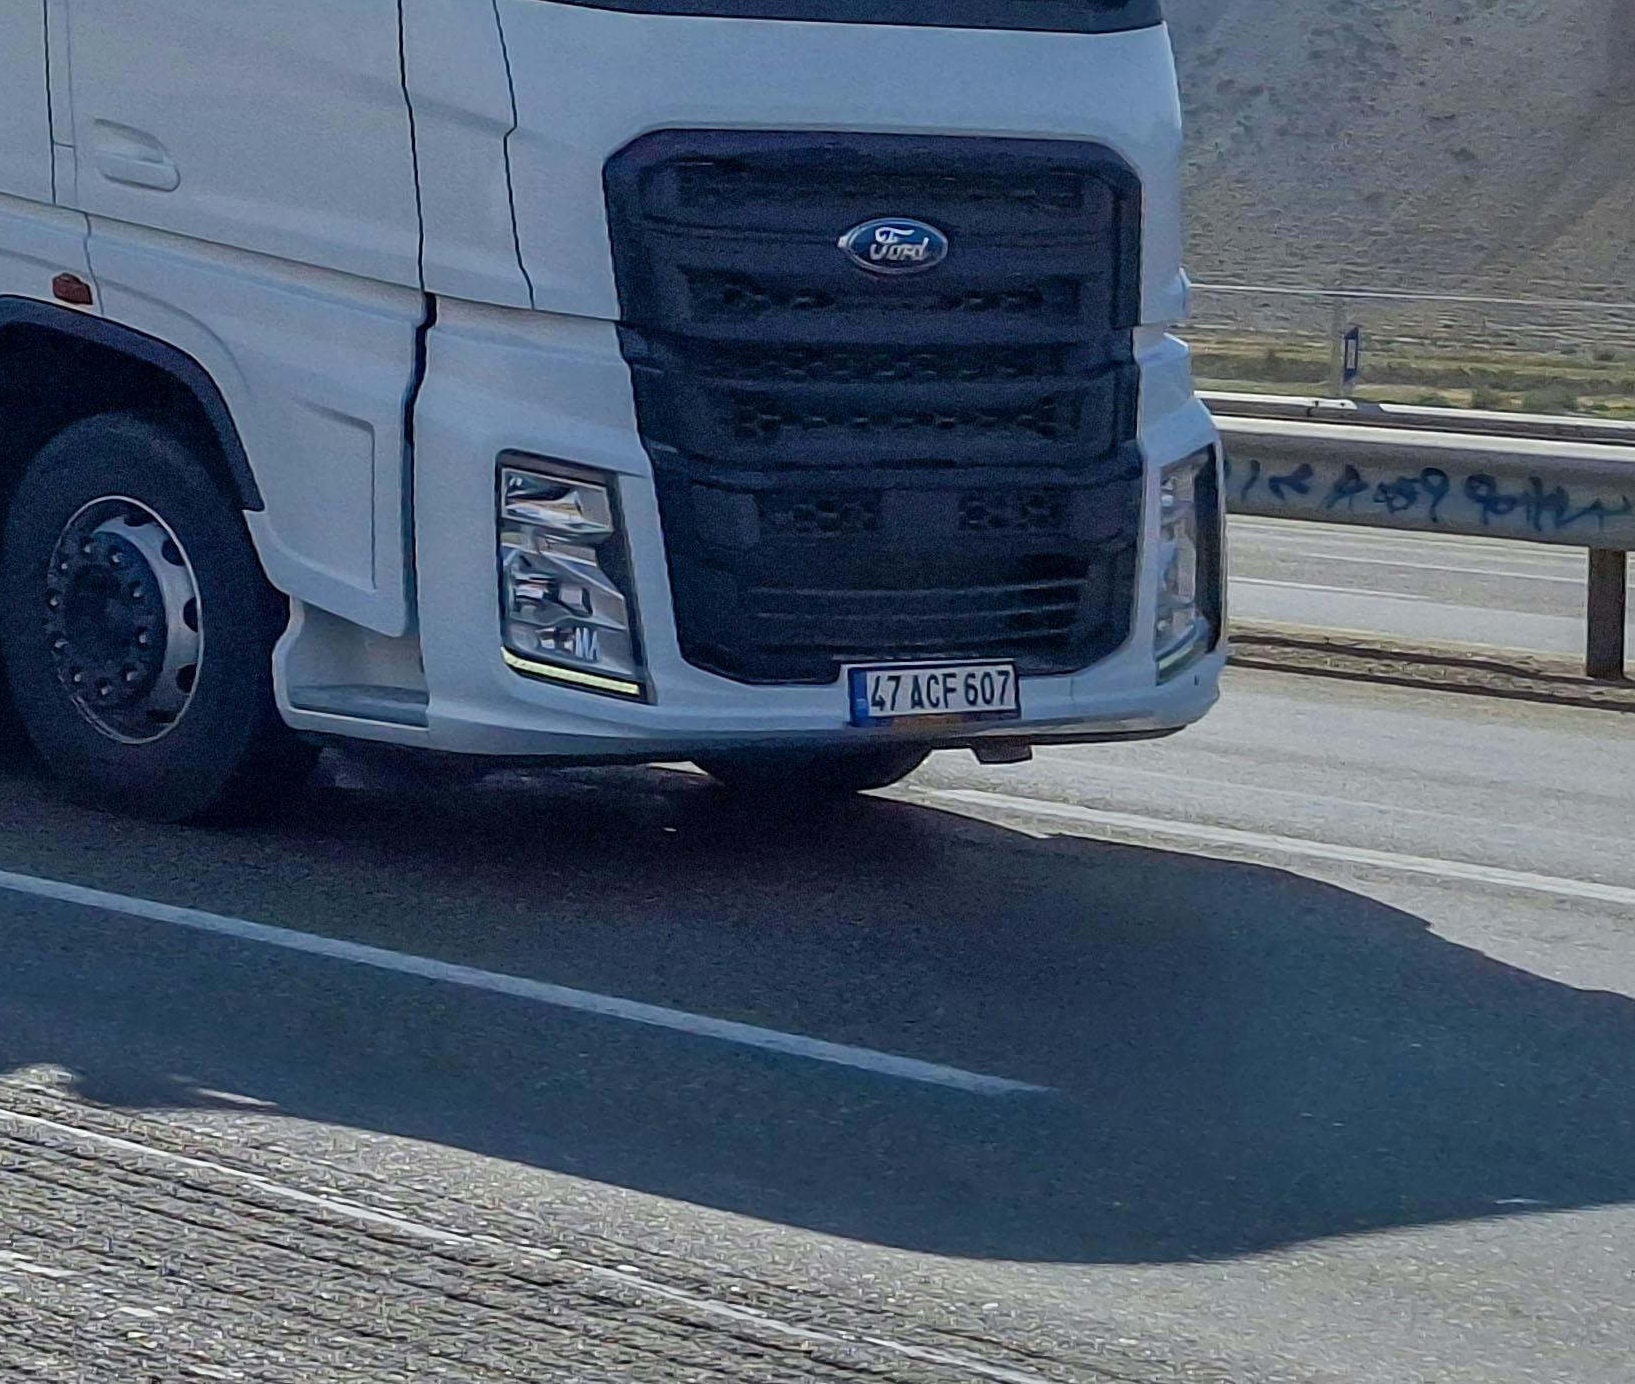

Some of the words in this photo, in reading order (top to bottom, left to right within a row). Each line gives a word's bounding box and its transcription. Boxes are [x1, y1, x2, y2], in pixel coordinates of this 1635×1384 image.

[870, 227, 929, 260] Ford
[871, 675, 902, 711] 47
[910, 673, 957, 709] ACF
[964, 670, 1010, 706] 607
